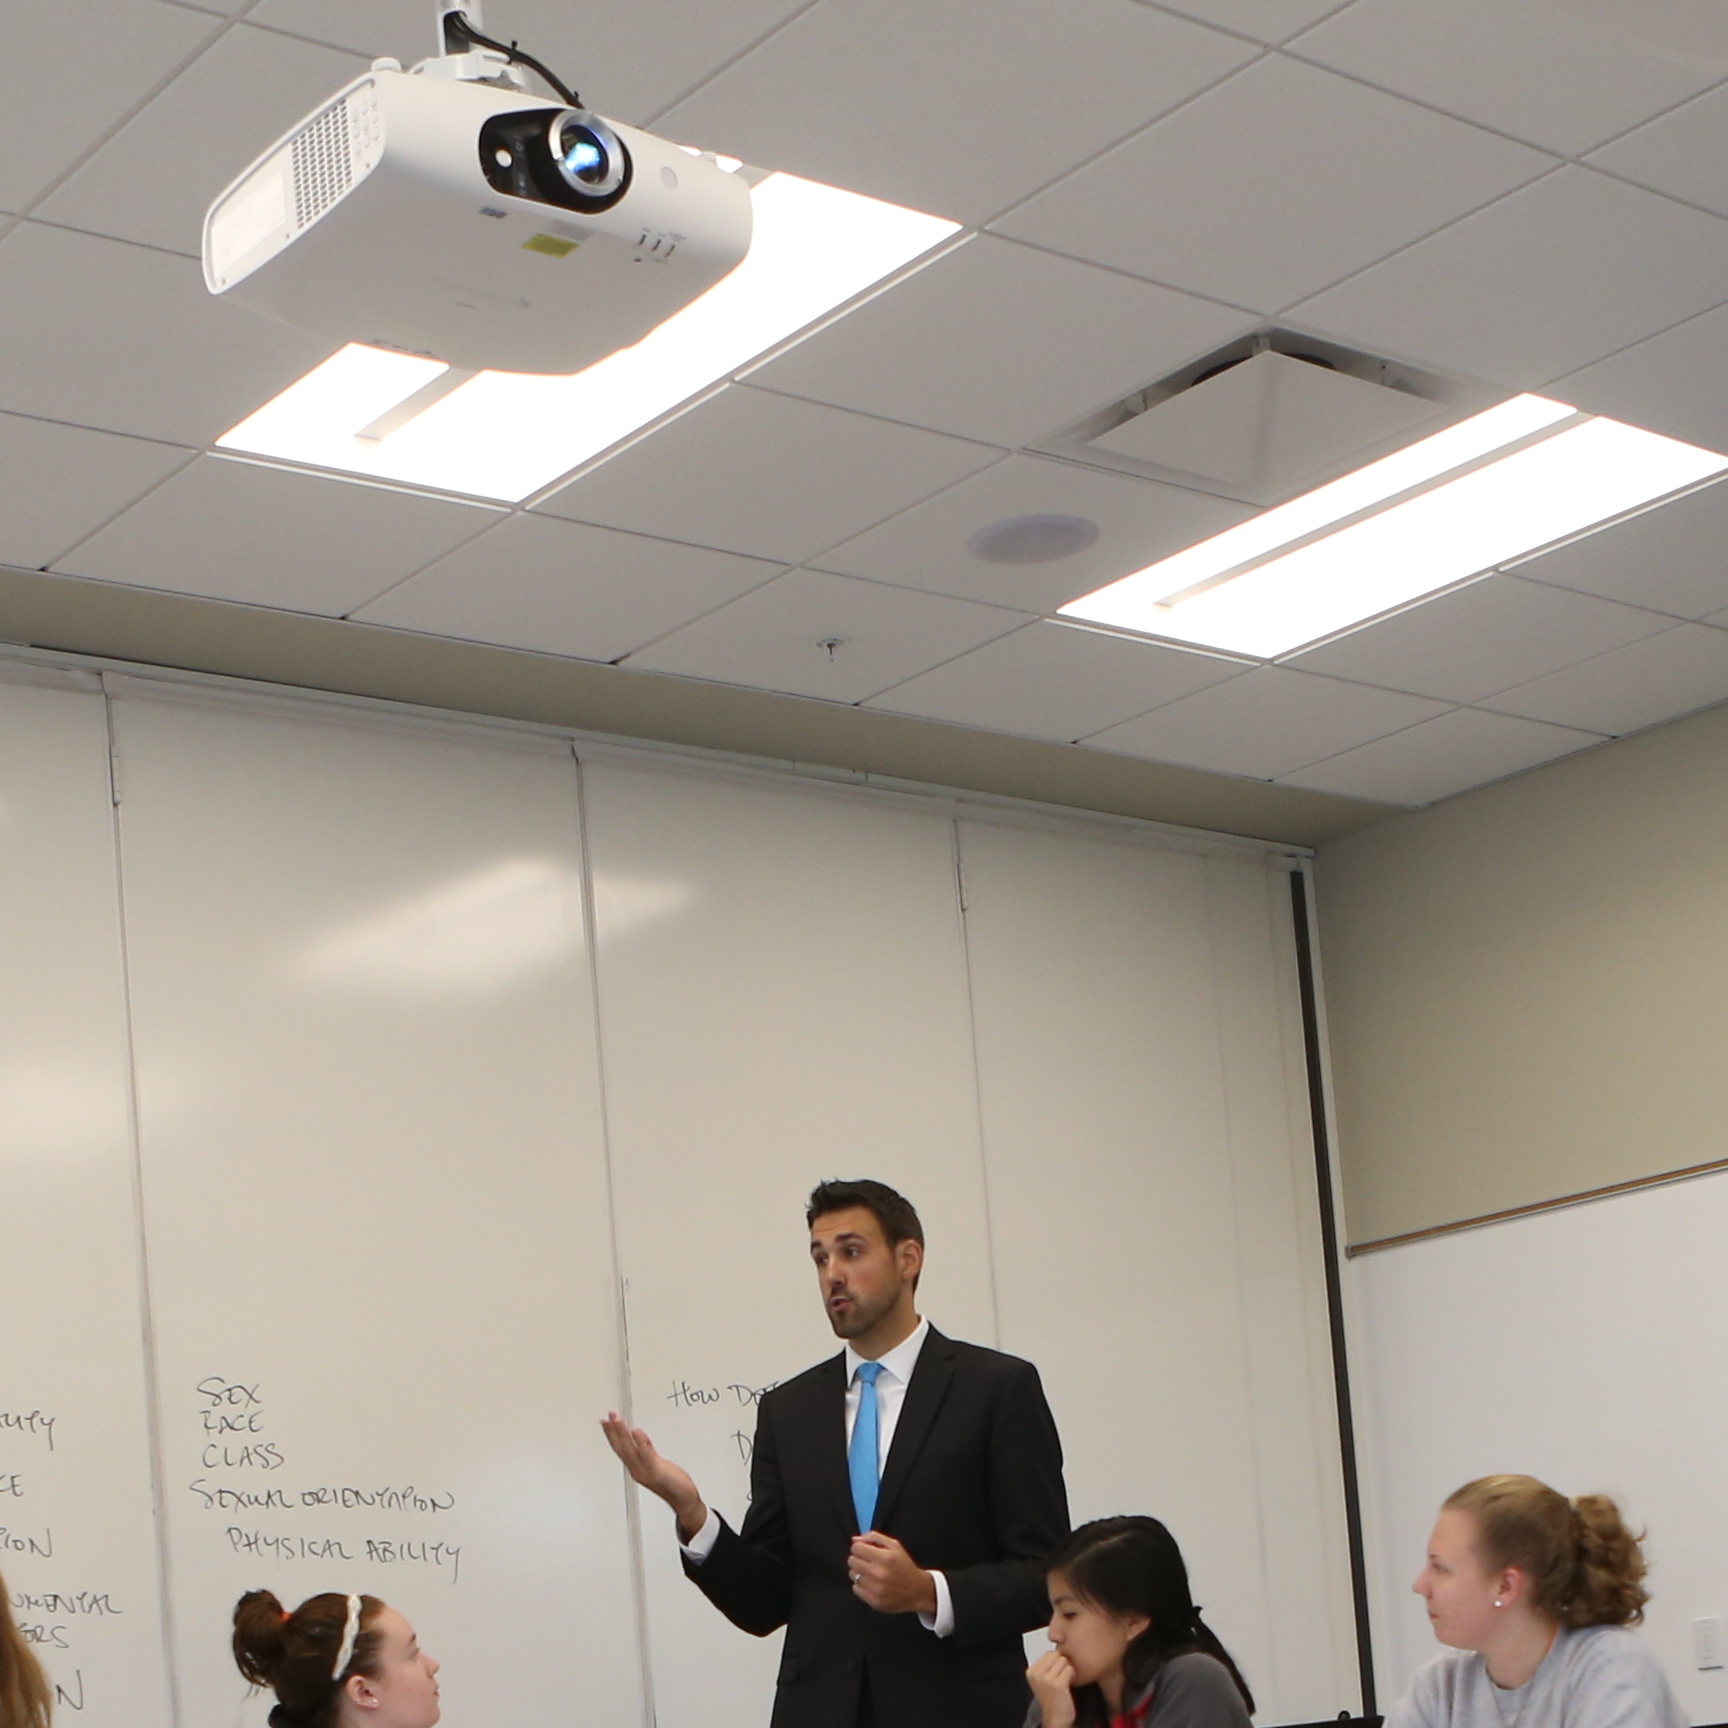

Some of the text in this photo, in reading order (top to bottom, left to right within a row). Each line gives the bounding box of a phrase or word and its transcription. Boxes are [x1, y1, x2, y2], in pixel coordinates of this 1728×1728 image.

[196, 1375, 263, 1408] SEX
[667, 1380, 721, 1407] HOW
[199, 1409, 265, 1438] RACE
[201, 1442, 286, 1471] CLASS
[188, 1477, 457, 1514] SEXUAL ORIENTATION
[225, 1525, 463, 1585] PHYSICAL ABILITY
